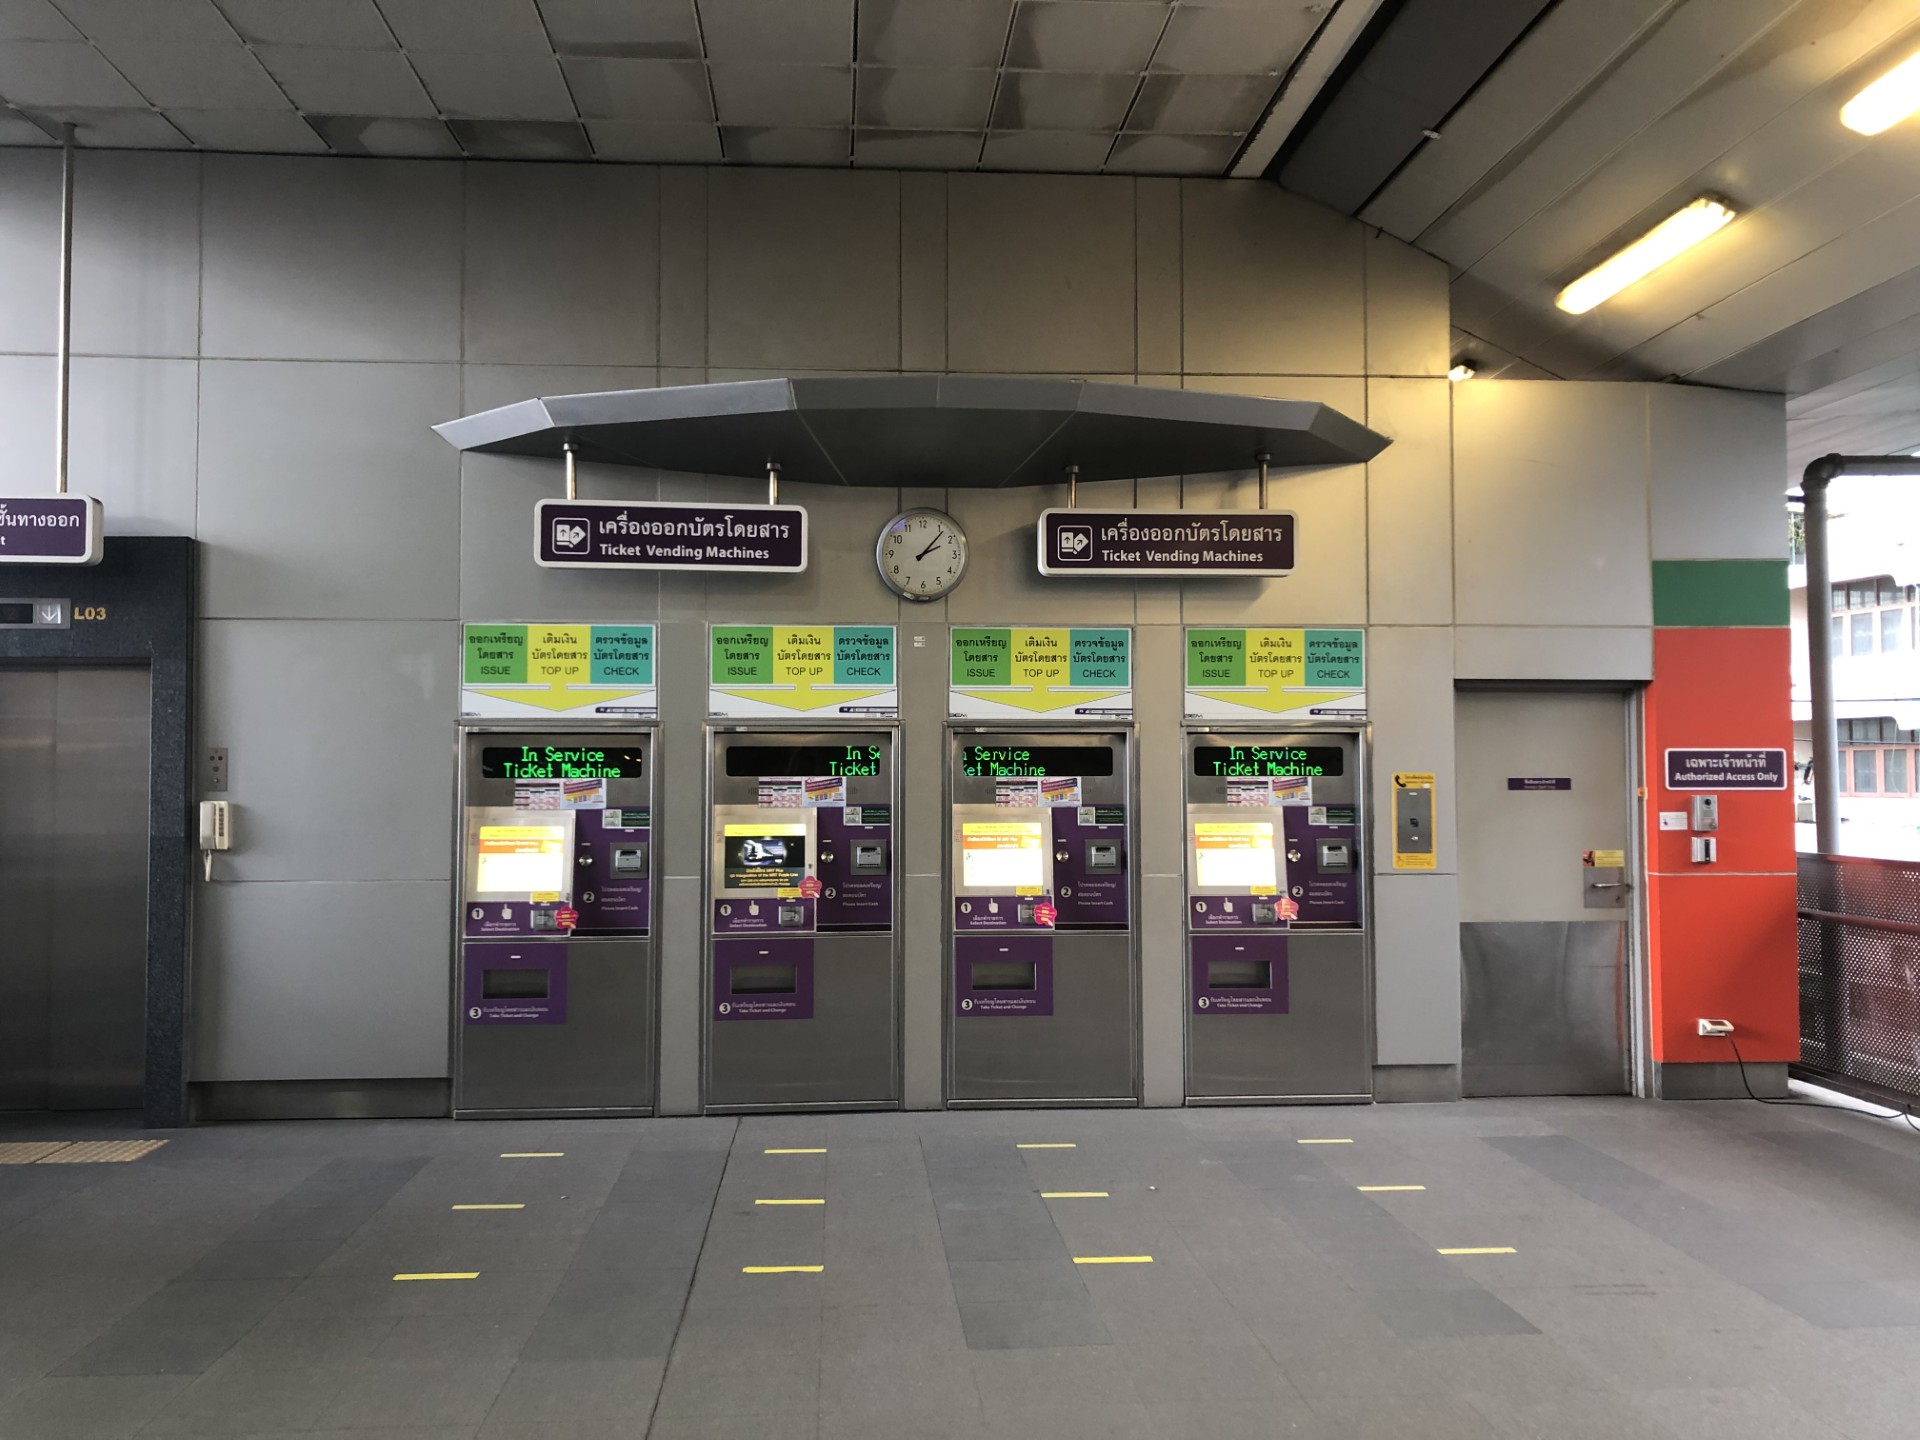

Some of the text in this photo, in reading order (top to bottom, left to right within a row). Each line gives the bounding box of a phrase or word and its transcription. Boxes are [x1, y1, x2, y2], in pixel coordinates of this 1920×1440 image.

[599, 510, 789, 539] เครื่องออกบัตรโดยสาร
[904, 524, 911, 532] 11
[919, 520, 927, 528] 12
[1101, 518, 1282, 542] เครื่องออกบัตรโดยสาร
[893, 535, 903, 544] 10
[947, 535, 953, 544] 2
[600, 543, 769, 560] Ticket Vending Machines
[888, 550, 894, 558] 9
[952, 550, 957, 559] 3
[1102, 550, 1263, 565] Ticket Vending Machines
[893, 566, 899, 574] 8
[947, 566, 952, 574] 4
[905, 577, 911, 585] 7
[920, 581, 926, 589] 6
[936, 577, 941, 585] 5
[74, 606, 107, 620] L03
[469, 632, 523, 647] ออกเหรียญ
[543, 632, 577, 645] เติมเงิน
[595, 633, 648, 649] ตรวจข้อมูล
[716, 634, 768, 647] ออกเหรียญ
[787, 634, 821, 645] เติมเงิน
[838, 634, 889, 649] ตรวจข้อมูล
[956, 636, 1007, 650] ออกเหรียญ
[1025, 636, 1057, 648] เติมเงิน
[1074, 637, 1124, 651] ตรวจข้อมูล
[1191, 637, 1241, 650] ออกเหรียญ
[1260, 637, 1292, 648] เติมเงิน
[1309, 638, 1358, 651] ตรวจข้อมูล
[477, 648, 514, 660] โดยสาร
[532, 649, 588, 660] บัตรโดยสาร
[594, 649, 649, 661] บัตรโดยสาร
[724, 649, 760, 660] โดยสาร
[777, 650, 831, 661] บัตรโดยสาร
[837, 650, 890, 661] บัตรโดยสาร
[963, 651, 998, 663] โดยสาร
[1015, 651, 1067, 663] บัตรโดยสาร
[1073, 652, 1126, 663] บัตรโดยสาร
[1199, 652, 1233, 663] โดยสาร
[1250, 652, 1302, 664] บัตรโดยสาร
[1307, 653, 1360, 664] บัตรโดยสาร
[480, 666, 511, 675] ISSUE
[541, 666, 579, 675] TOP UP
[603, 667, 639, 676] CHECK
[727, 667, 757, 676] ISSUE
[786, 667, 823, 676] TOP UP
[846, 667, 881, 676] CHECK
[967, 669, 995, 677] ISSUE
[1024, 669, 1059, 678] TOP UP
[1082, 669, 1116, 678] CHECK
[1202, 670, 1230, 678] ISSUE
[1258, 669, 1294, 678] TOP UP
[1317, 670, 1350, 678] CHECK
[521, 746, 604, 762] In Service
[846, 745, 861, 760] In
[975, 746, 1030, 760] Service
[1229, 745, 1307, 760] In Service
[1686, 752, 1766, 768] เฉพาะเจ้าหน้าที่
[504, 763, 621, 778] Ticket Machine
[829, 761, 876, 776] Ticket
[990, 763, 1045, 776] Machine
[1213, 762, 1323, 776] Ticket Machine
[1675, 772, 1778, 782] Authorized Access Only
